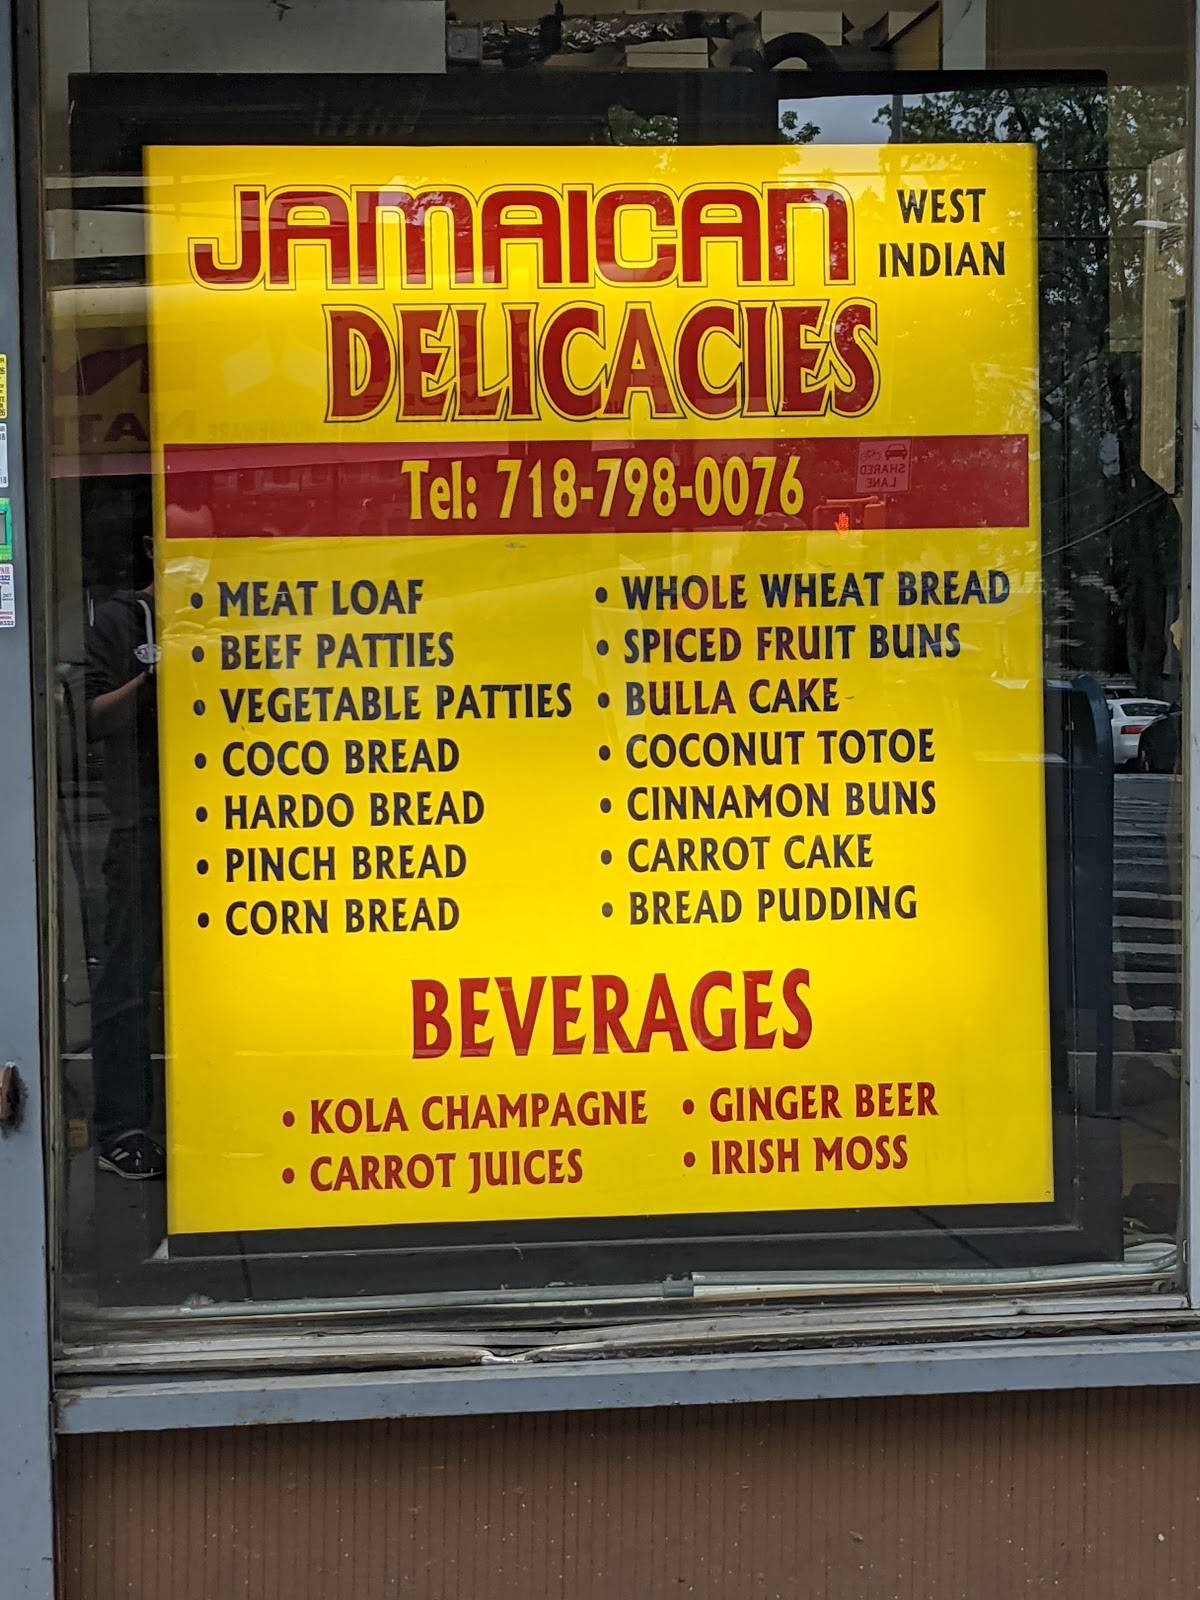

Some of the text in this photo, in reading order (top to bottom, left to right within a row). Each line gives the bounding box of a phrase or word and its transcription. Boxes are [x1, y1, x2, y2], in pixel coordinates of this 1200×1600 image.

[897, 189, 986, 223] WEST
[189, 181, 855, 291] JAMAICAN
[880, 242, 1004, 277] INDIAN
[322, 297, 881, 423] DELICACIES
[401, 456, 804, 521] Tel: 718-798-0076
[217, 580, 423, 616] MEAT LOAF
[622, 570, 1009, 610] WHOLE WHEAT BREAD
[221, 632, 453, 670] BEEF PATTIES
[625, 623, 960, 663] SPICED FRUIT BUNS
[220, 683, 571, 723] VEGETABLE PATTIES
[627, 678, 839, 715] BULLA CAKE
[223, 738, 459, 776] COCO BREAD
[627, 729, 935, 768] COCONUT TOTOE
[225, 791, 484, 829] HARDO BREAD
[628, 781, 935, 821] CINNAMON BUNS
[226, 845, 466, 882] PINCH BREAD
[629, 834, 872, 872] CARROT CAKE
[226, 898, 459, 935] CORN BREAD
[630, 885, 916, 924] BREAD PUDDING
[412, 969, 812, 1059] BEVERAGES
[311, 1091, 647, 1134] KOLA CHAMPAGNE
[710, 1082, 938, 1122] GINGER BEER
[311, 1149, 582, 1193] CARROT JUICES
[712, 1135, 907, 1174] IRISH MOSS
